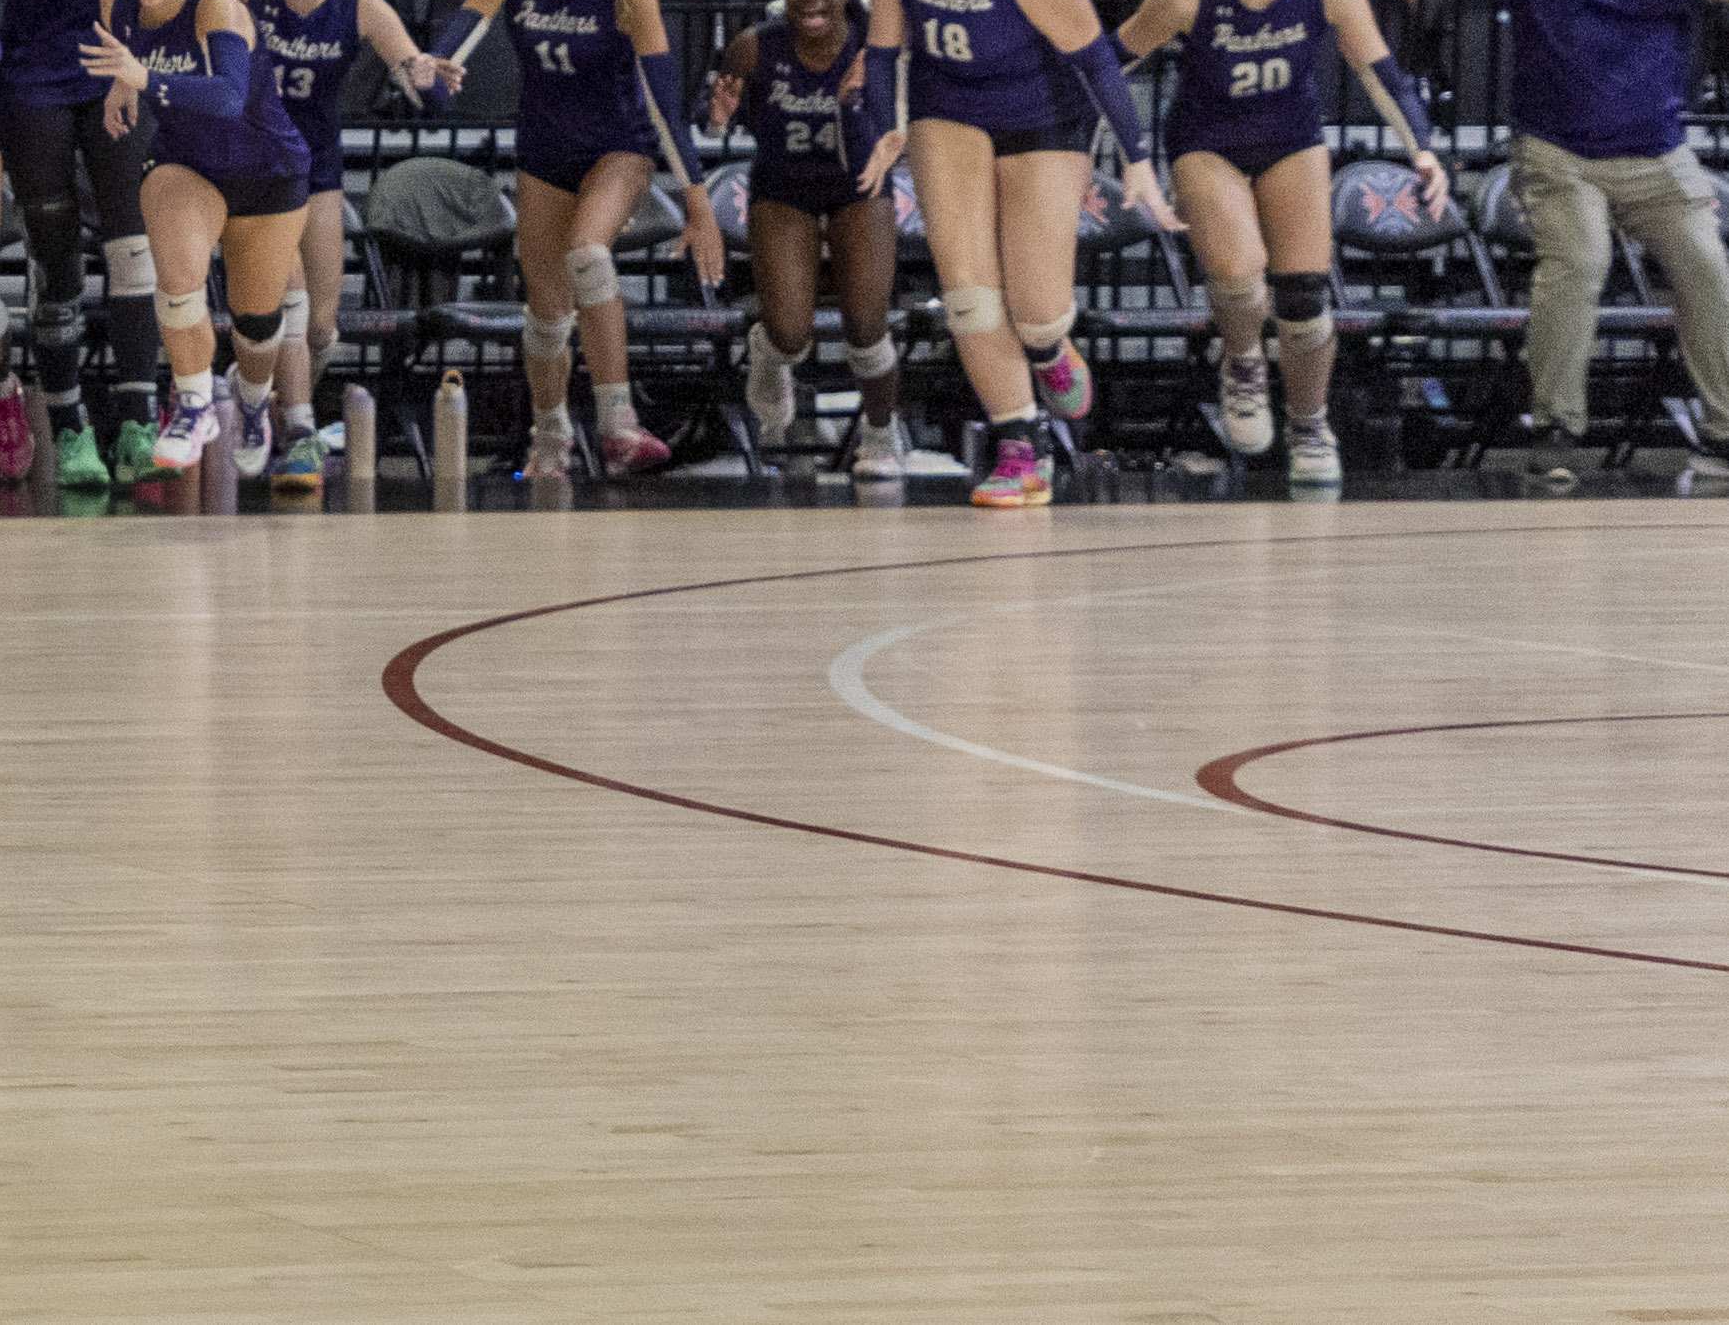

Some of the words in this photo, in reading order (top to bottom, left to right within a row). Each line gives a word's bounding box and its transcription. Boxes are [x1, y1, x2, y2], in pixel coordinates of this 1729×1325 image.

[514, 0, 599, 35] Panthers
[260, 19, 342, 62] Panthers
[923, 18, 974, 62] 18
[1210, 21, 1308, 53] Panthers
[534, 40, 576, 75] 11
[274, 64, 314, 99] 13
[1230, 57, 1293, 97] 20
[786, 120, 837, 154] 24
